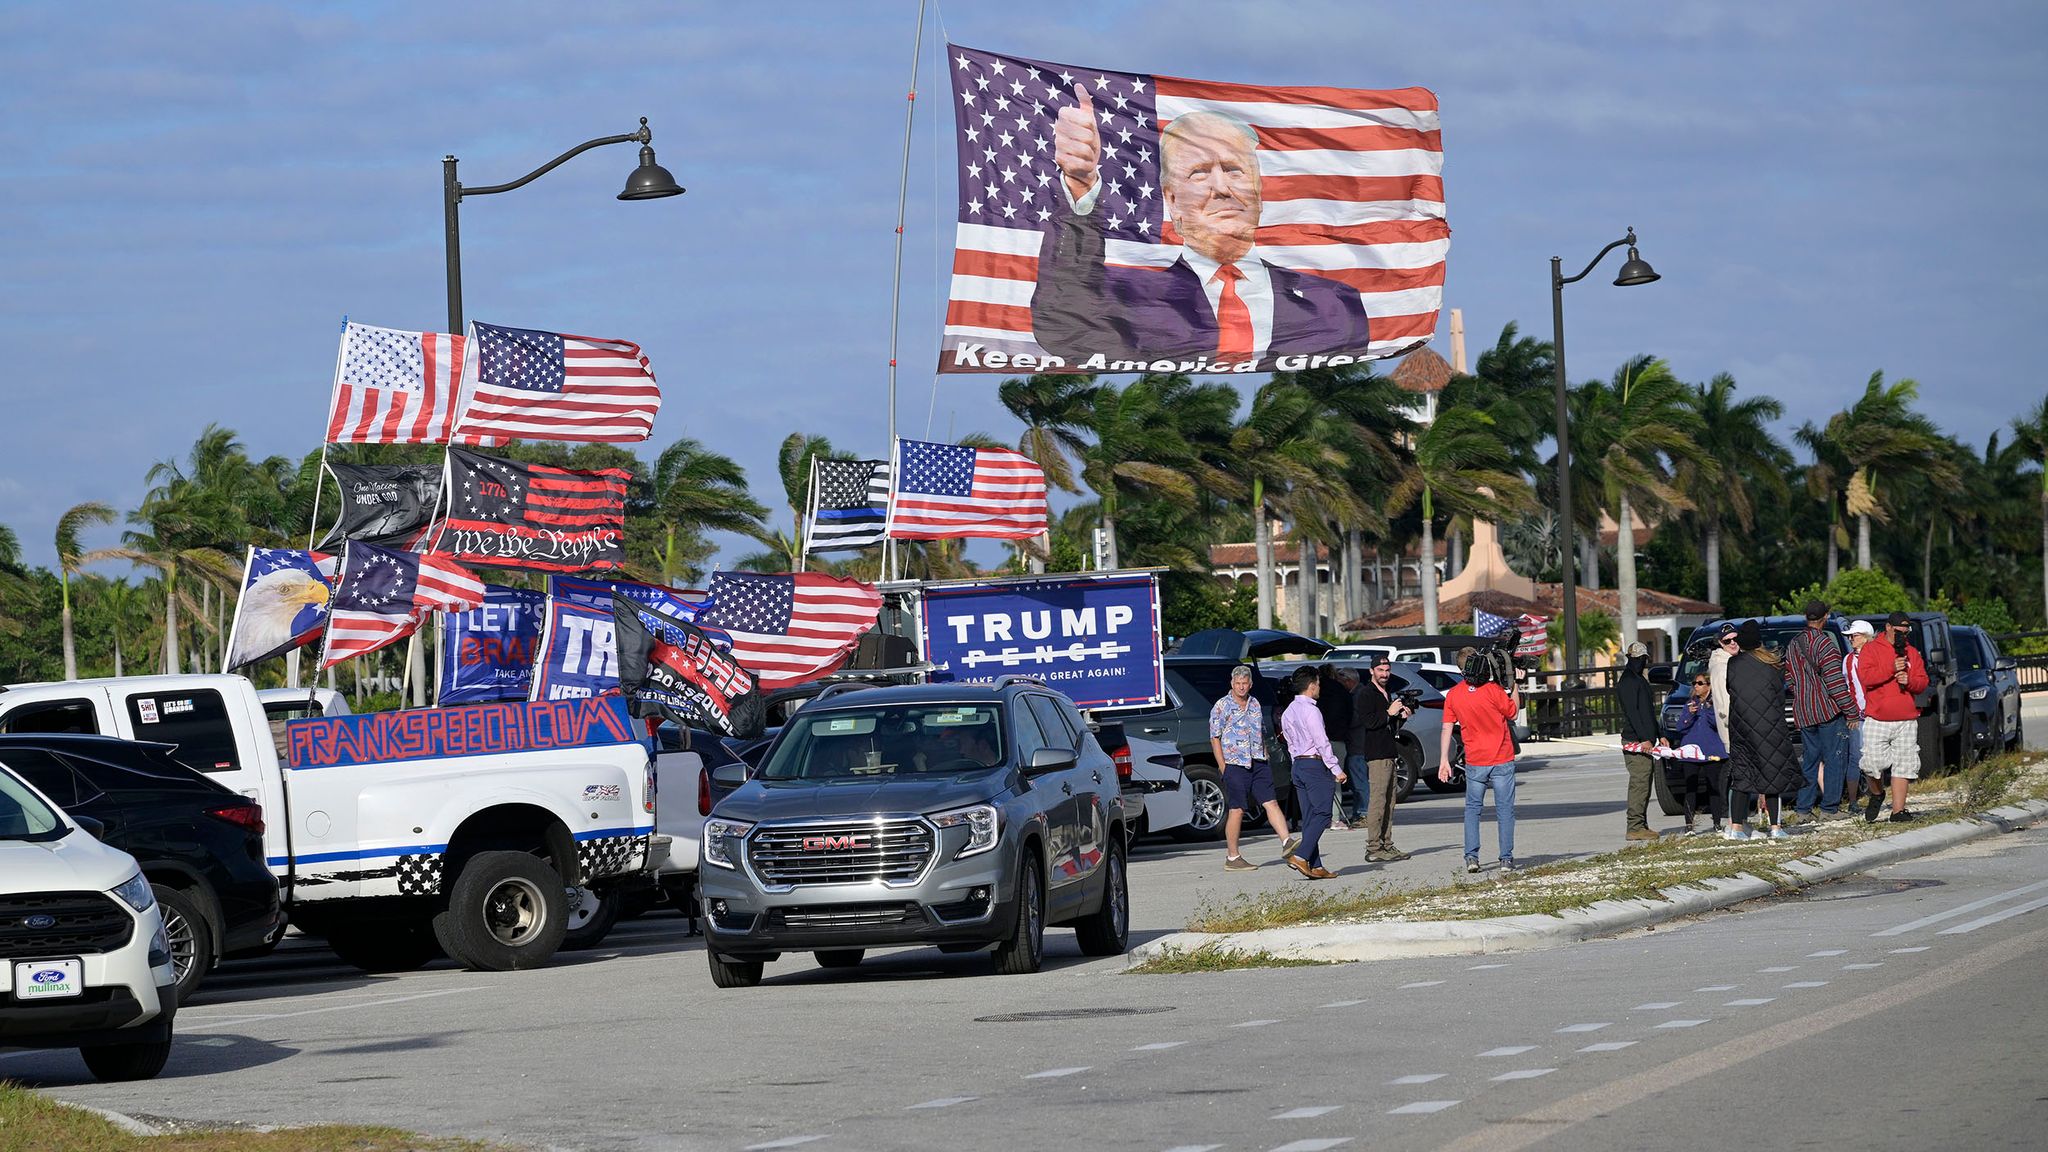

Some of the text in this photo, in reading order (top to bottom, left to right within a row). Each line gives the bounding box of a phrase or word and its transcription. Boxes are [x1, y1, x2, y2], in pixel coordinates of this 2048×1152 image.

[954, 342, 1065, 372] Keep
[479, 481, 507, 498] 1776
[356, 491, 398, 505] UNDER GOD
[453, 526, 619, 568] We the People
[947, 604, 1133, 644] TRUMP
[967, 640, 1120, 669] PENCE
[494, 668, 516, 679] TAKE
[1050, 669, 1084, 681] GREAT
[1087, 667, 1126, 678] AGAIN!
[141, 703, 155, 712] SHIT
[685, 687, 735, 737] SEQUEL
[803, 834, 871, 850] GMC
[38, 971, 60, 982] Ford
[28, 981, 71, 993] mullinax
